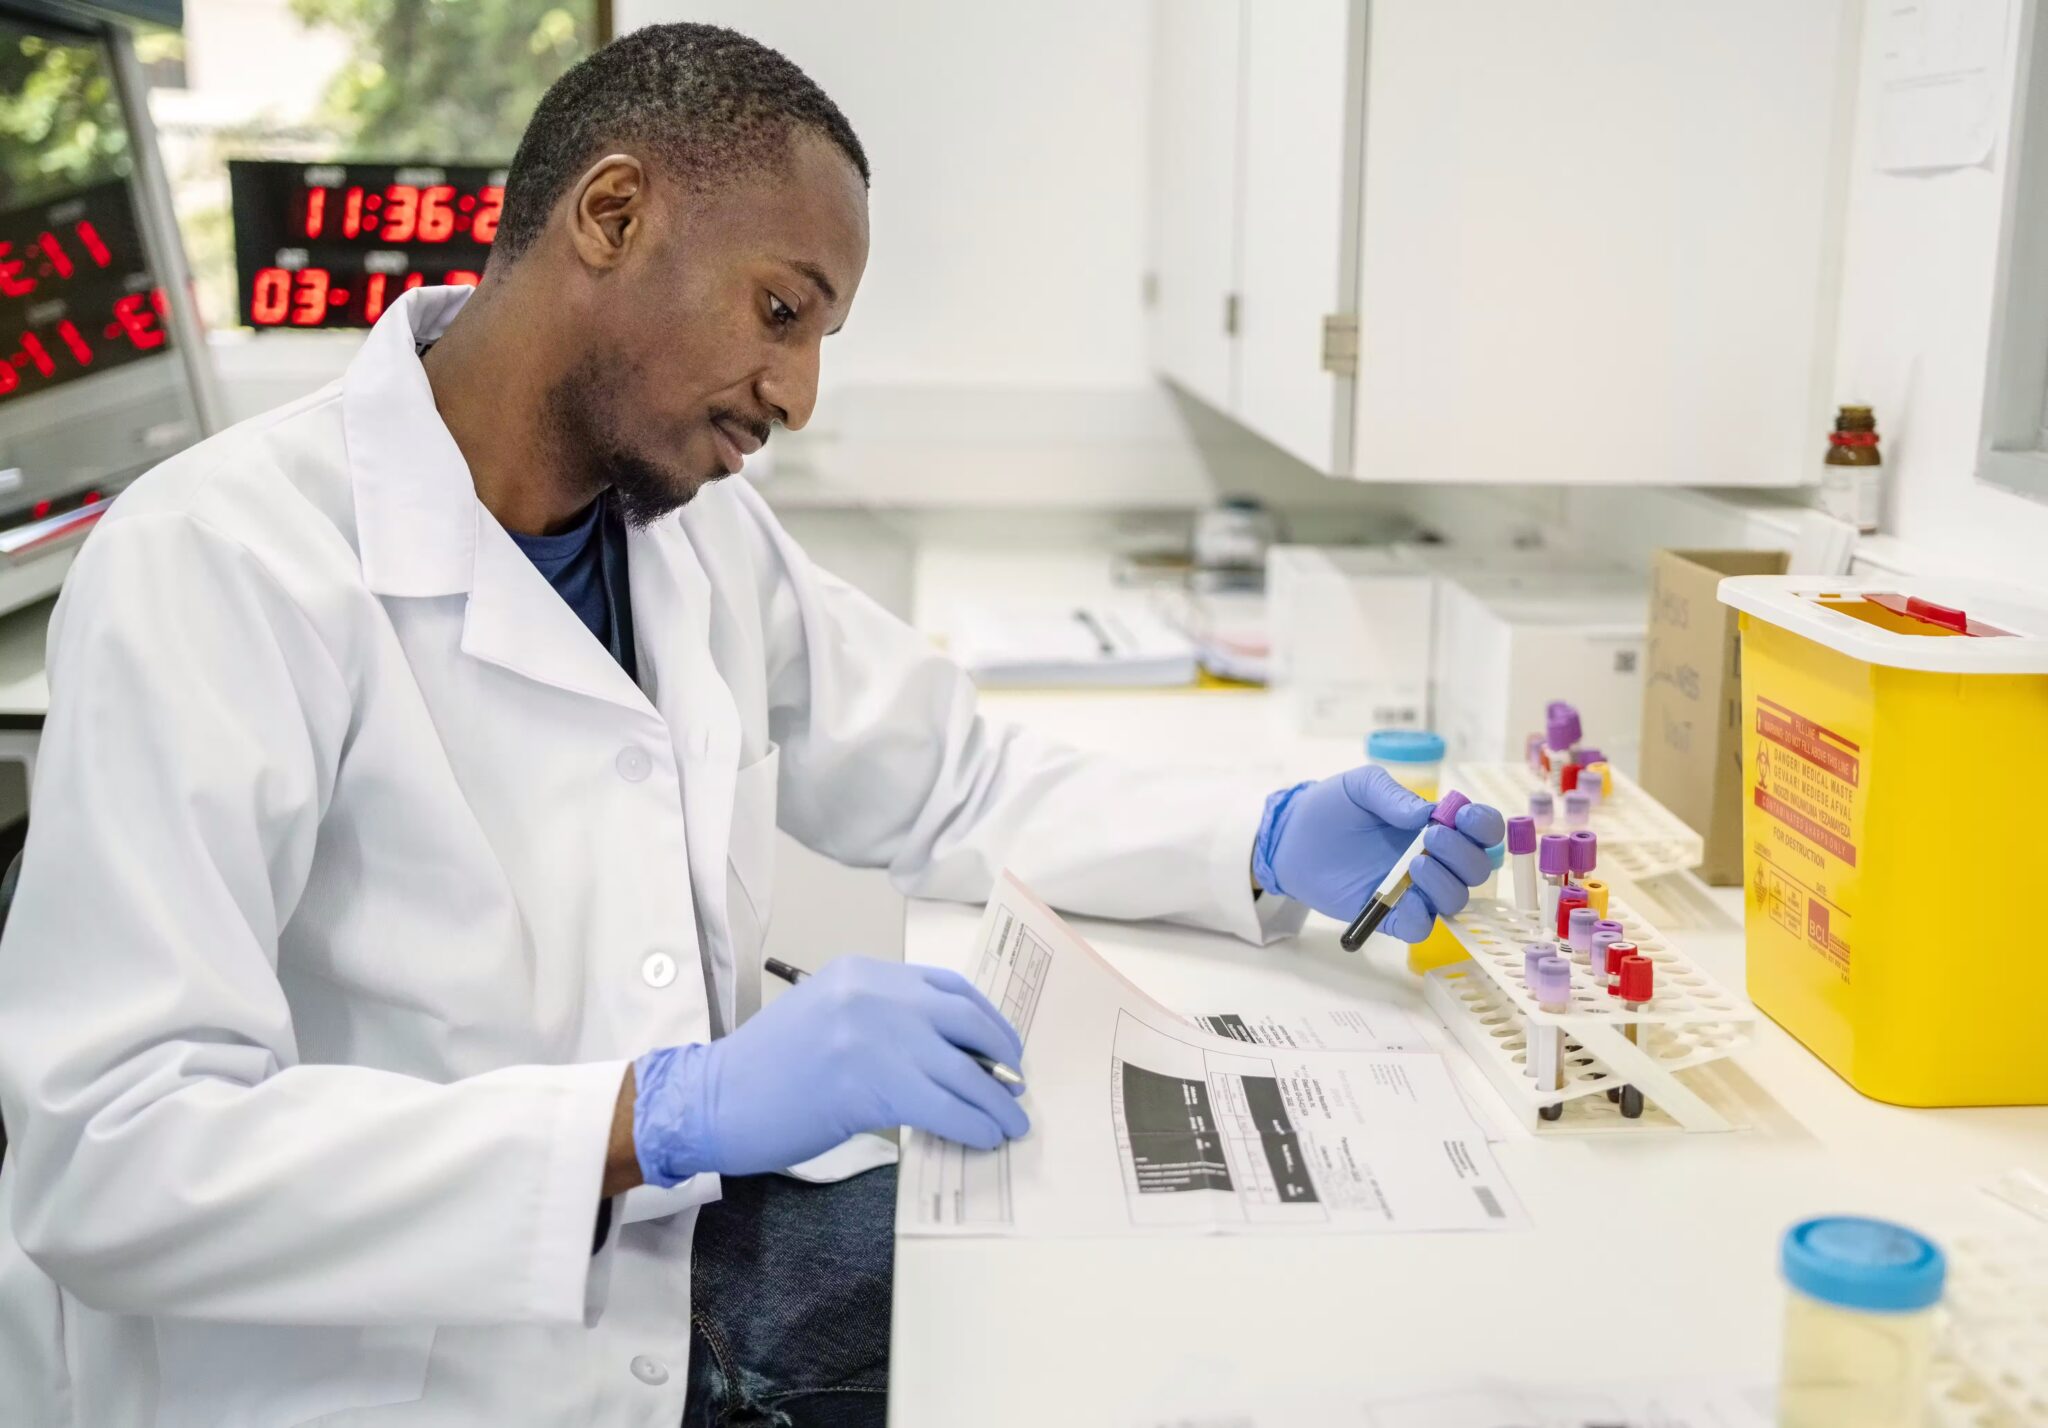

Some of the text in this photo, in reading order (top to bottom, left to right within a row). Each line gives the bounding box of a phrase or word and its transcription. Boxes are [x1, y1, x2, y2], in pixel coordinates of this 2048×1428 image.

[1801, 762, 1829, 790] MEDICAL
[1830, 777, 1853, 803] WASTE
[1801, 780, 1829, 808] MEDIESE
[1830, 797, 1852, 822] AFVAL
[1773, 826, 1785, 842] FOR
[1785, 834, 1825, 869] DESTRUCTION
[1829, 836, 1846, 857] ONLY
[1809, 919, 1828, 948] BCL
